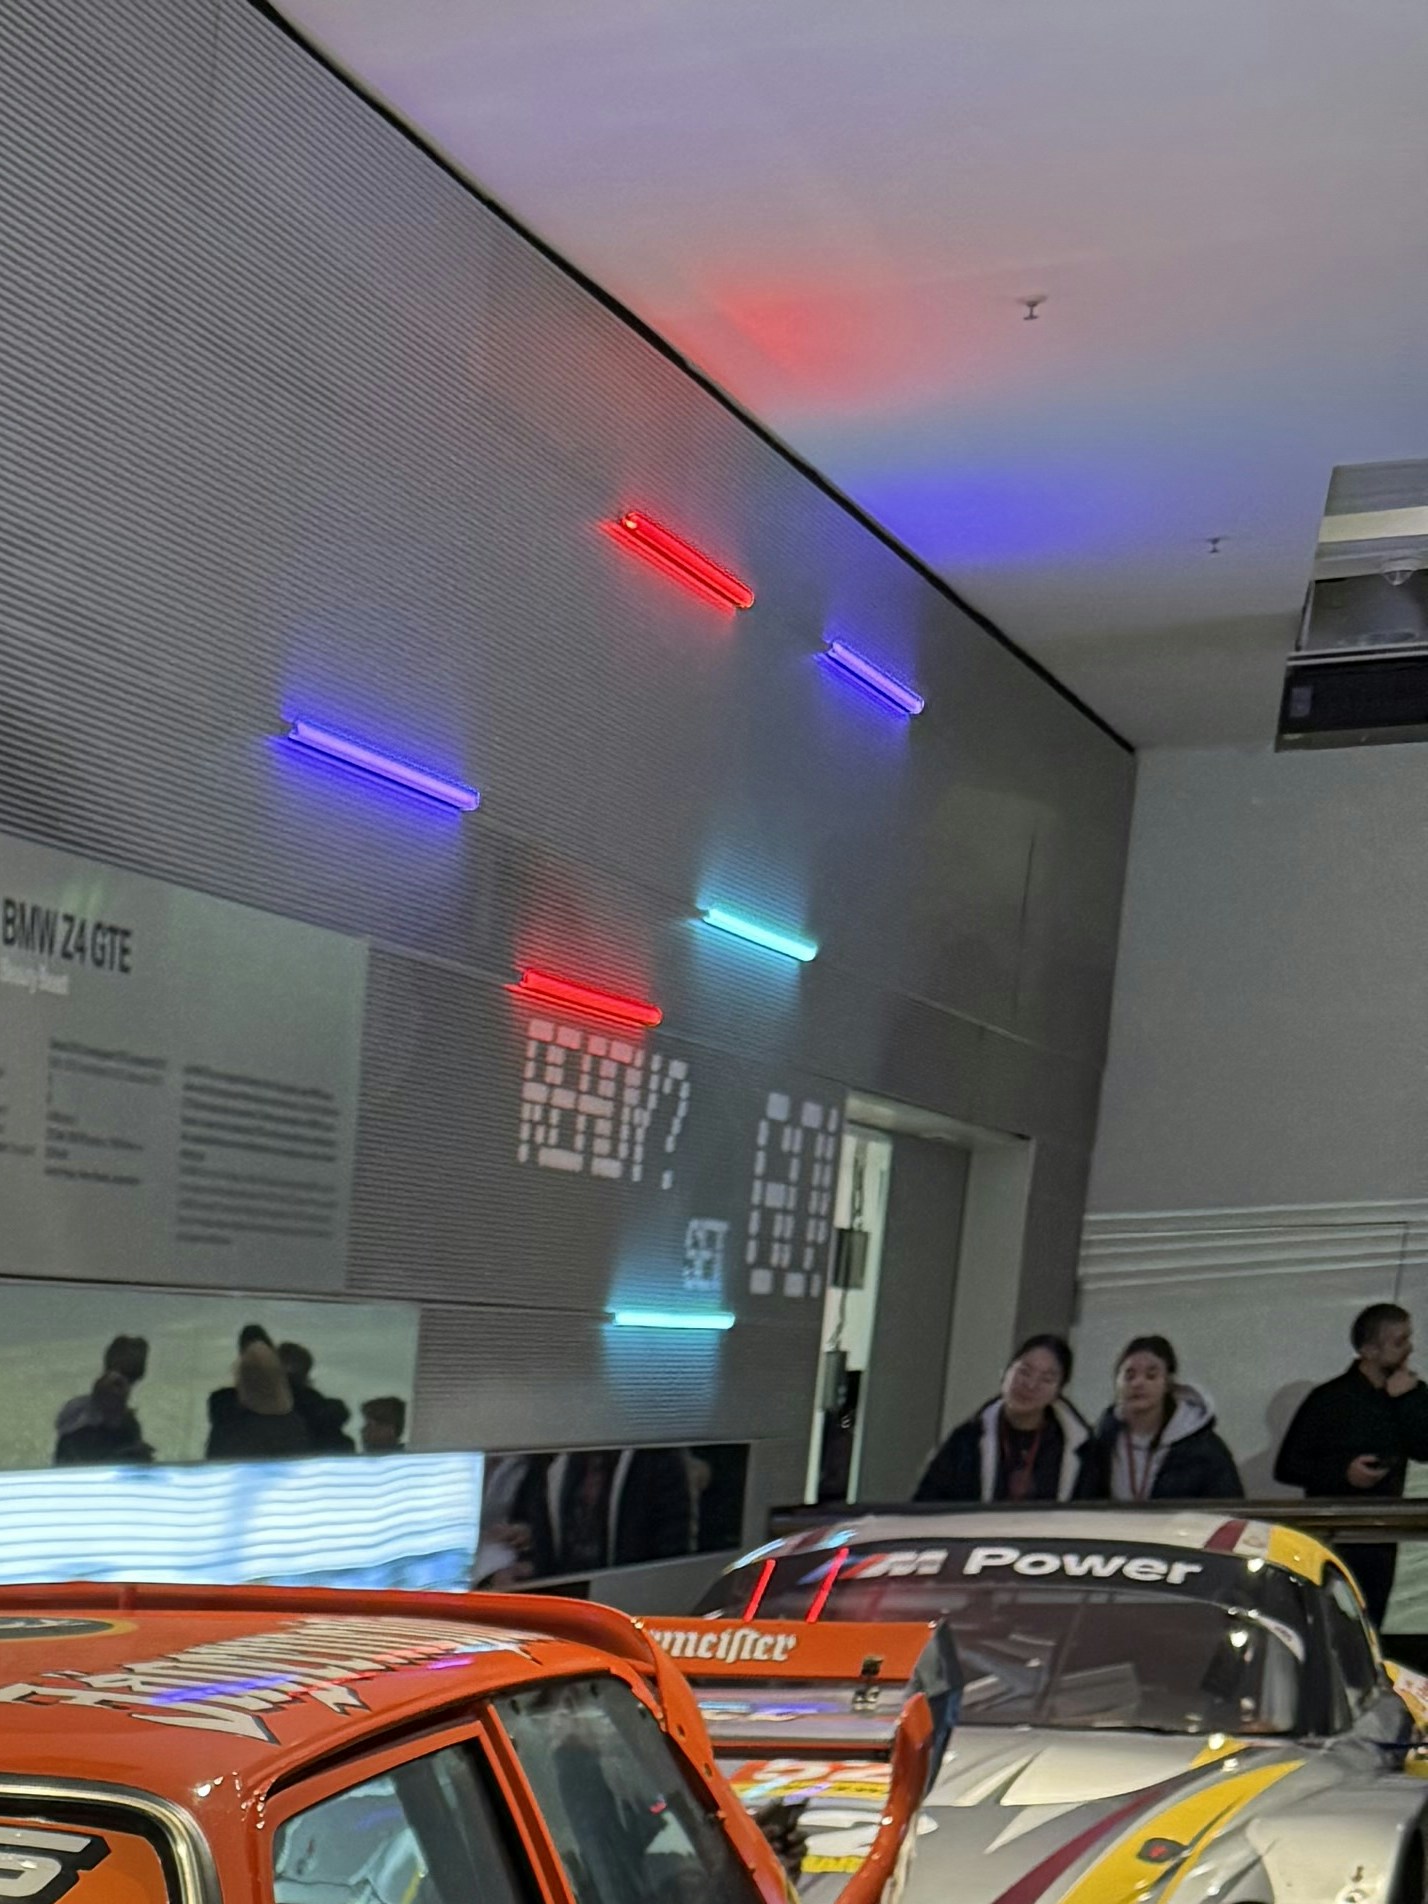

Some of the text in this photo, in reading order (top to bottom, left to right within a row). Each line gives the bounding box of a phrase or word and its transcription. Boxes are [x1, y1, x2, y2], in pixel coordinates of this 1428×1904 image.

[1, 897, 132, 975] BMW Z4 GTE
[963, 1546, 1203, 1585] Power
